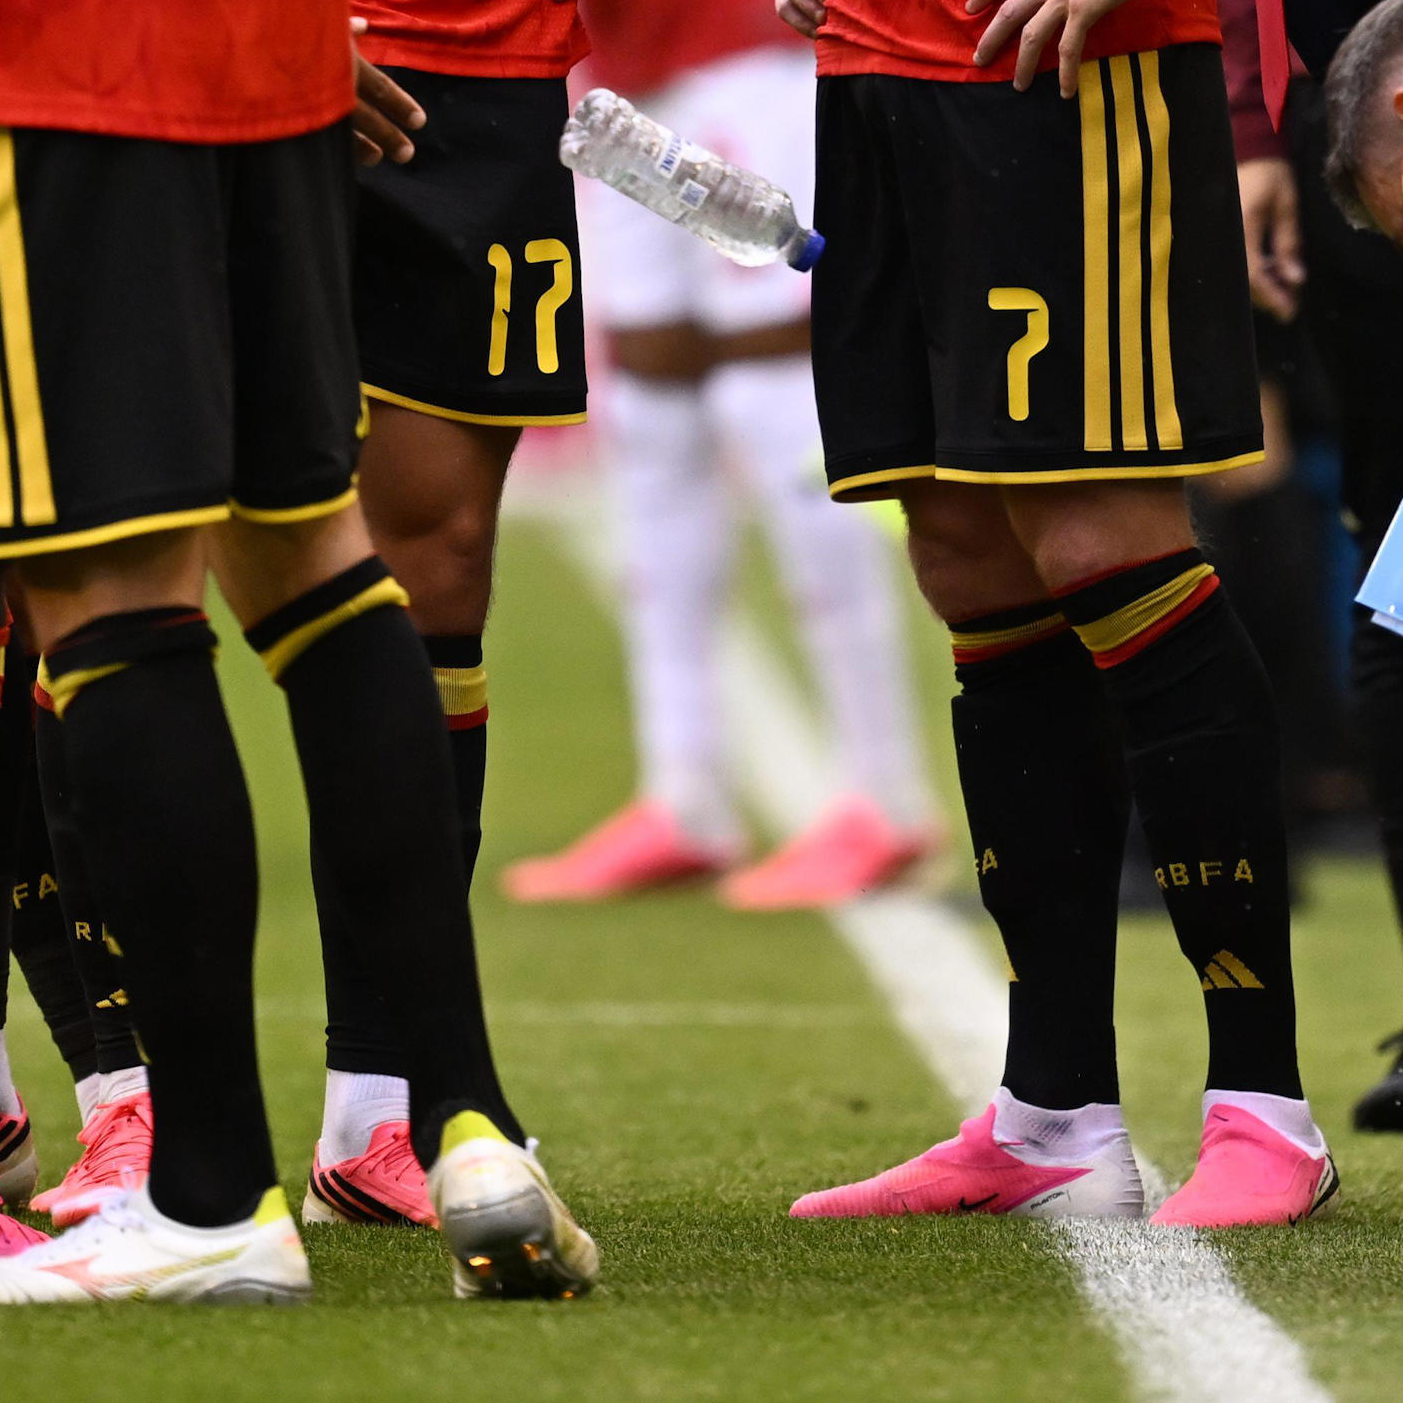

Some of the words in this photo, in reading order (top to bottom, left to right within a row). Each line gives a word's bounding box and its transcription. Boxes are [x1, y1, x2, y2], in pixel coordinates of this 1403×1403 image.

[487, 238, 573, 377] 17
[987, 287, 1050, 422] 7
[1154, 858, 1254, 889] RBFA
